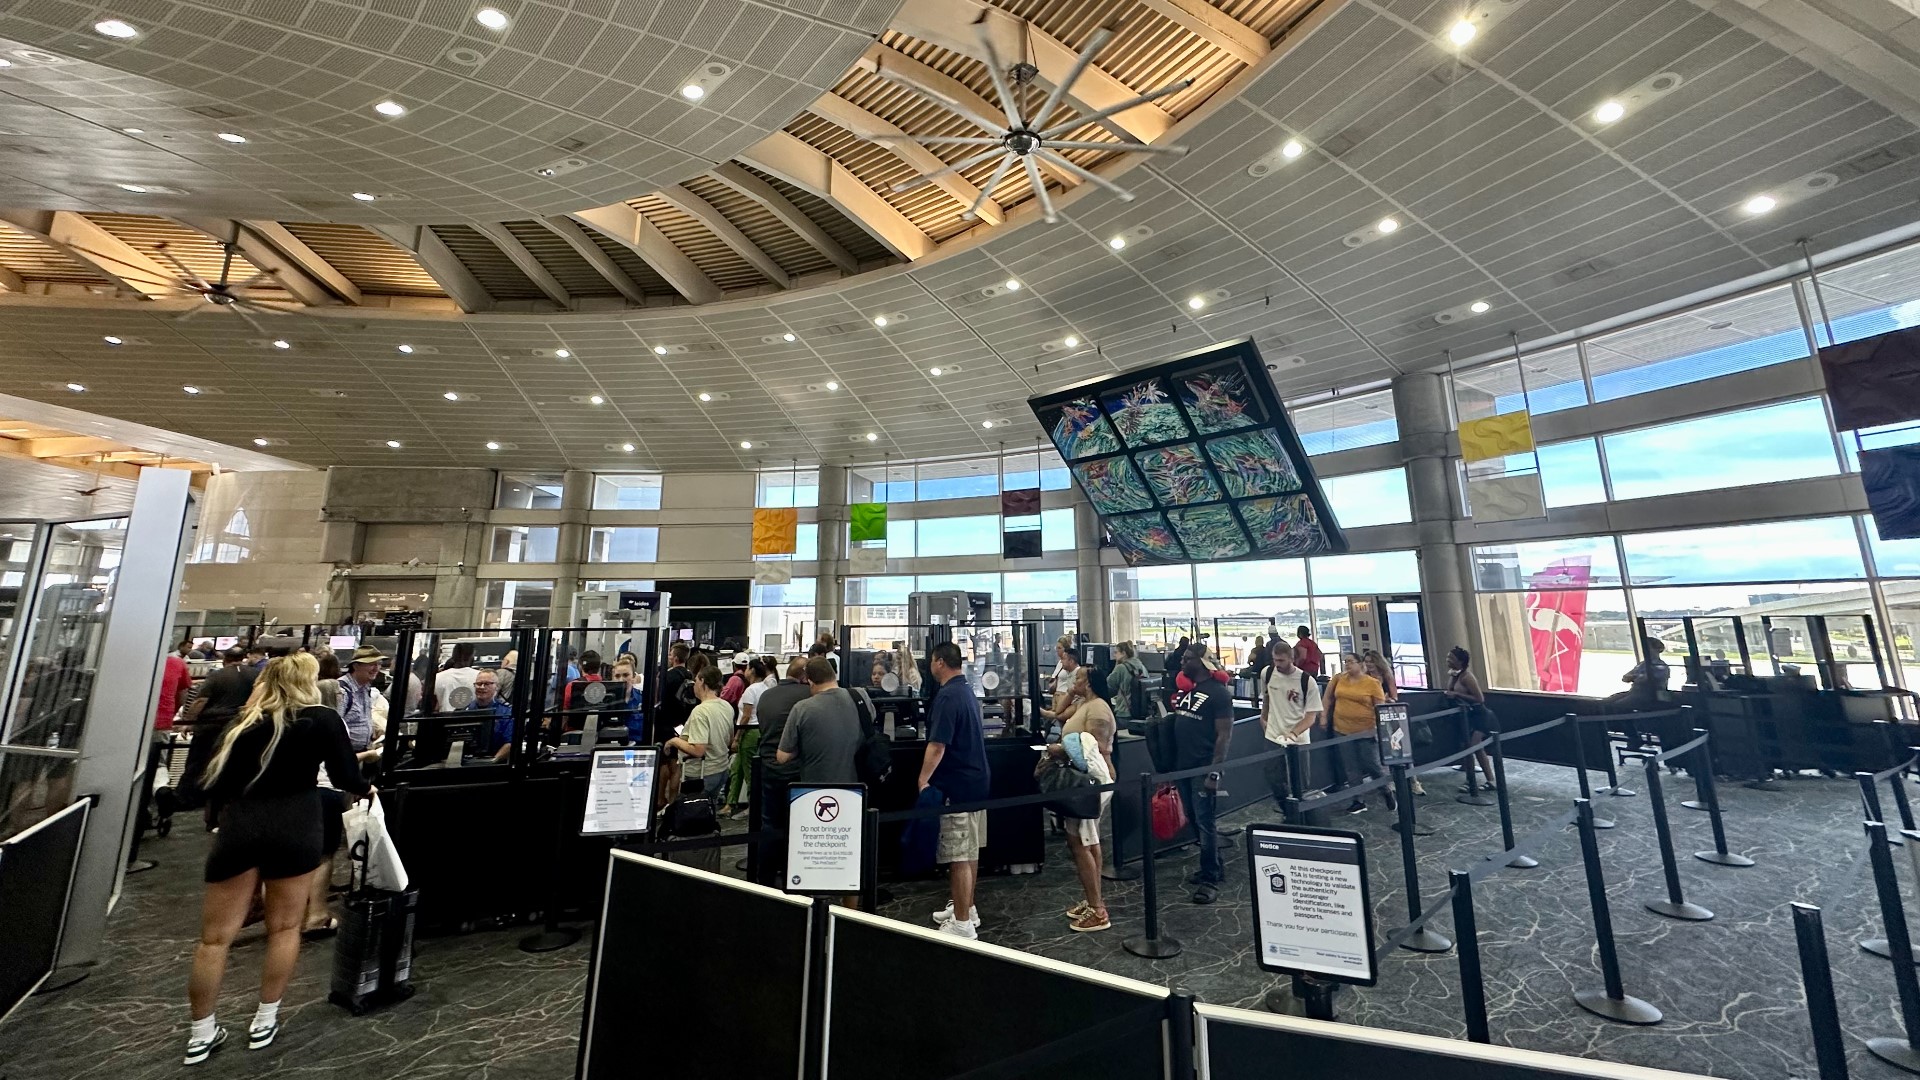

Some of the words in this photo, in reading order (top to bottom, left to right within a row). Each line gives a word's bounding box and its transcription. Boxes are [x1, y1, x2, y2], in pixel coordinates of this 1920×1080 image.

[1303, 887, 1337, 895] authenticity
[1293, 898, 1333, 908] identification,
[1321, 928, 1359, 937] participation.
